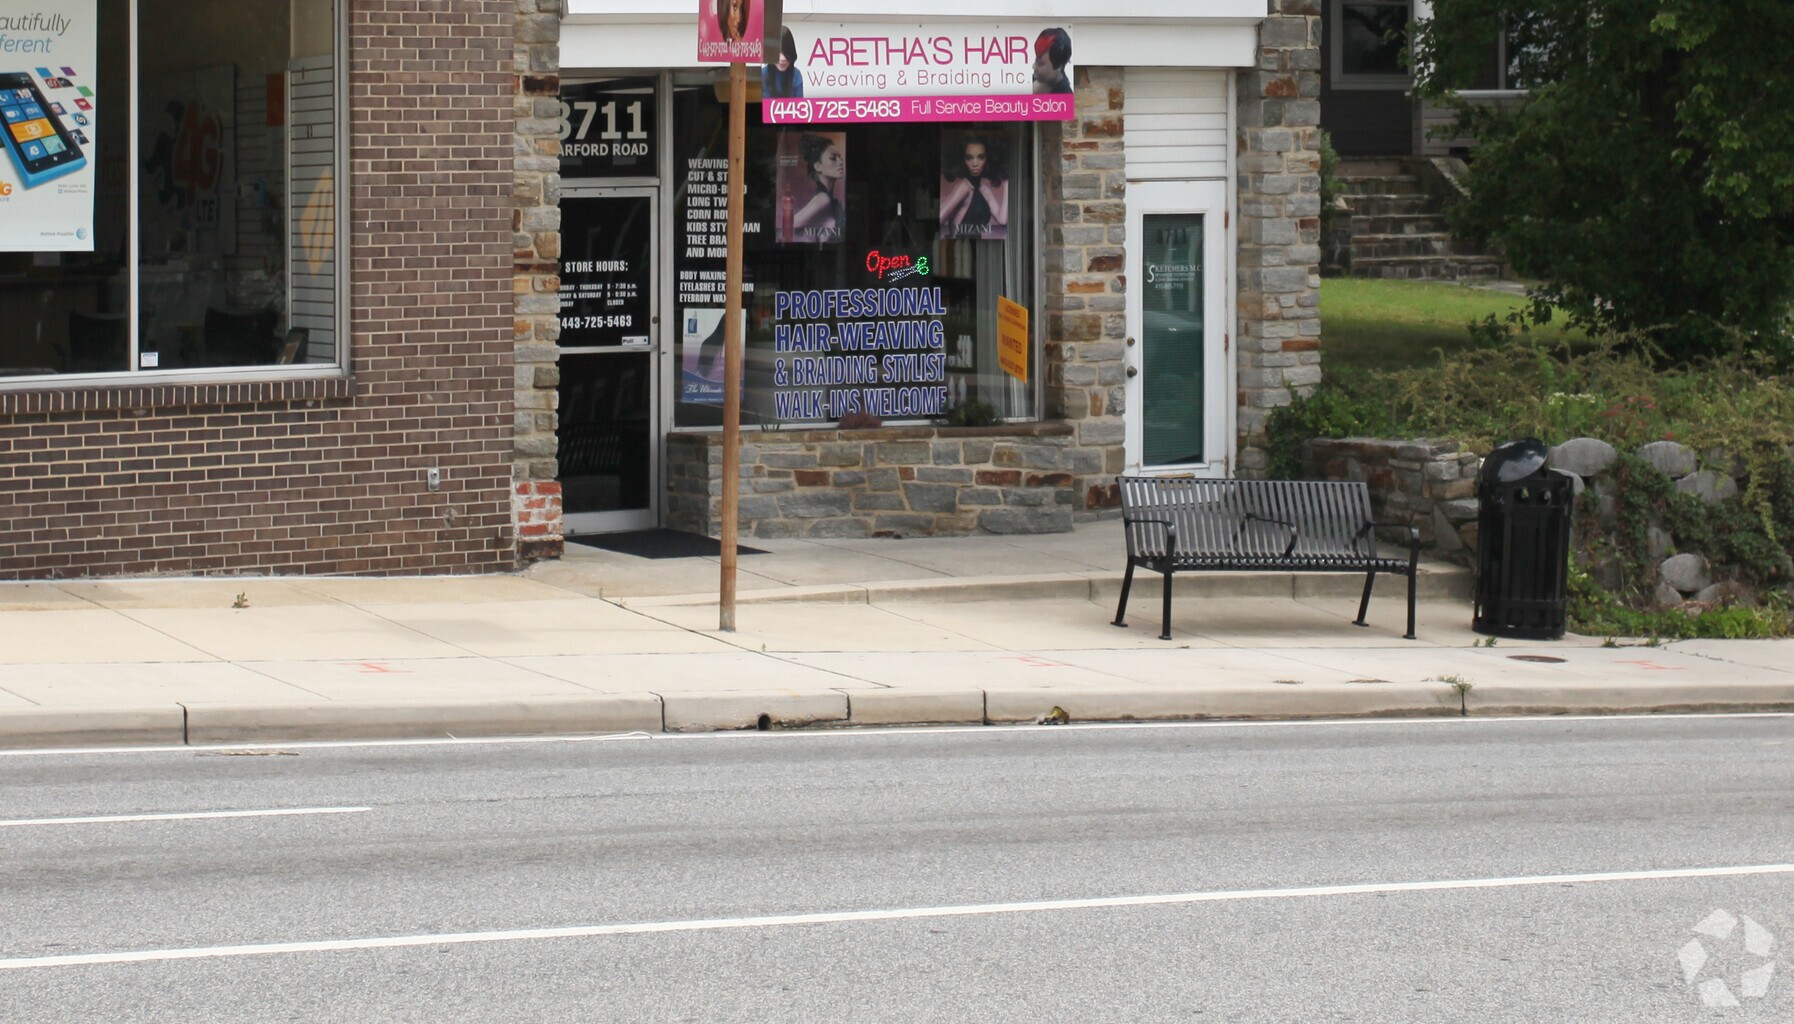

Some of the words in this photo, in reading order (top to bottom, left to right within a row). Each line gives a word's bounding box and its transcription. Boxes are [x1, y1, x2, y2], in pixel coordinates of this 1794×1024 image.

[807, 36, 953, 66] ARETHA'S
[964, 36, 1029, 65] HAIR
[807, 70, 887, 89] Weaving
[897, 69, 907, 86] &
[917, 69, 991, 88] Braiding
[1001, 69, 1030, 85] Inc.
[770, 100, 813, 123] (443)
[816, 100, 901, 118] 725-5463
[911, 100, 932, 115] Full
[935, 99, 982, 115] Service
[985, 98, 1029, 116] Beauty
[1032, 98, 1067, 113] Salon
[559, 144, 609, 156] ARFORD
[612, 143, 649, 156] ROAD
[688, 158, 728, 169] WEAVING
[687, 171, 705, 182] CUT
[707, 171, 715, 182] &
[687, 197, 710, 207] LONG
[687, 209, 711, 220] CORN
[686, 222, 708, 233] KIDS
[803, 226, 841, 237] MIZANI
[954, 223, 993, 235] MIZANI
[686, 234, 707, 245] TREE
[686, 247, 705, 258] AND
[565, 261, 593, 273] STORE
[596, 260, 629, 272] HOURS:
[866, 250, 911, 279] Open
[680, 271, 697, 280] BODY
[700, 271, 726, 280] WAXING
[679, 282, 715, 292] EYELASHES
[679, 294, 711, 303] EYEBROW
[775, 287, 947, 320] PROFESSIONAL
[561, 315, 632, 329] 443-725-5463
[775, 320, 944, 353] HAIR-WEAVING
[774, 358, 788, 386] &
[793, 355, 877, 385] BRAIDING
[882, 353, 947, 383] STYLIST
[774, 389, 860, 419] WALK-INS
[864, 387, 947, 416] WELCOME
